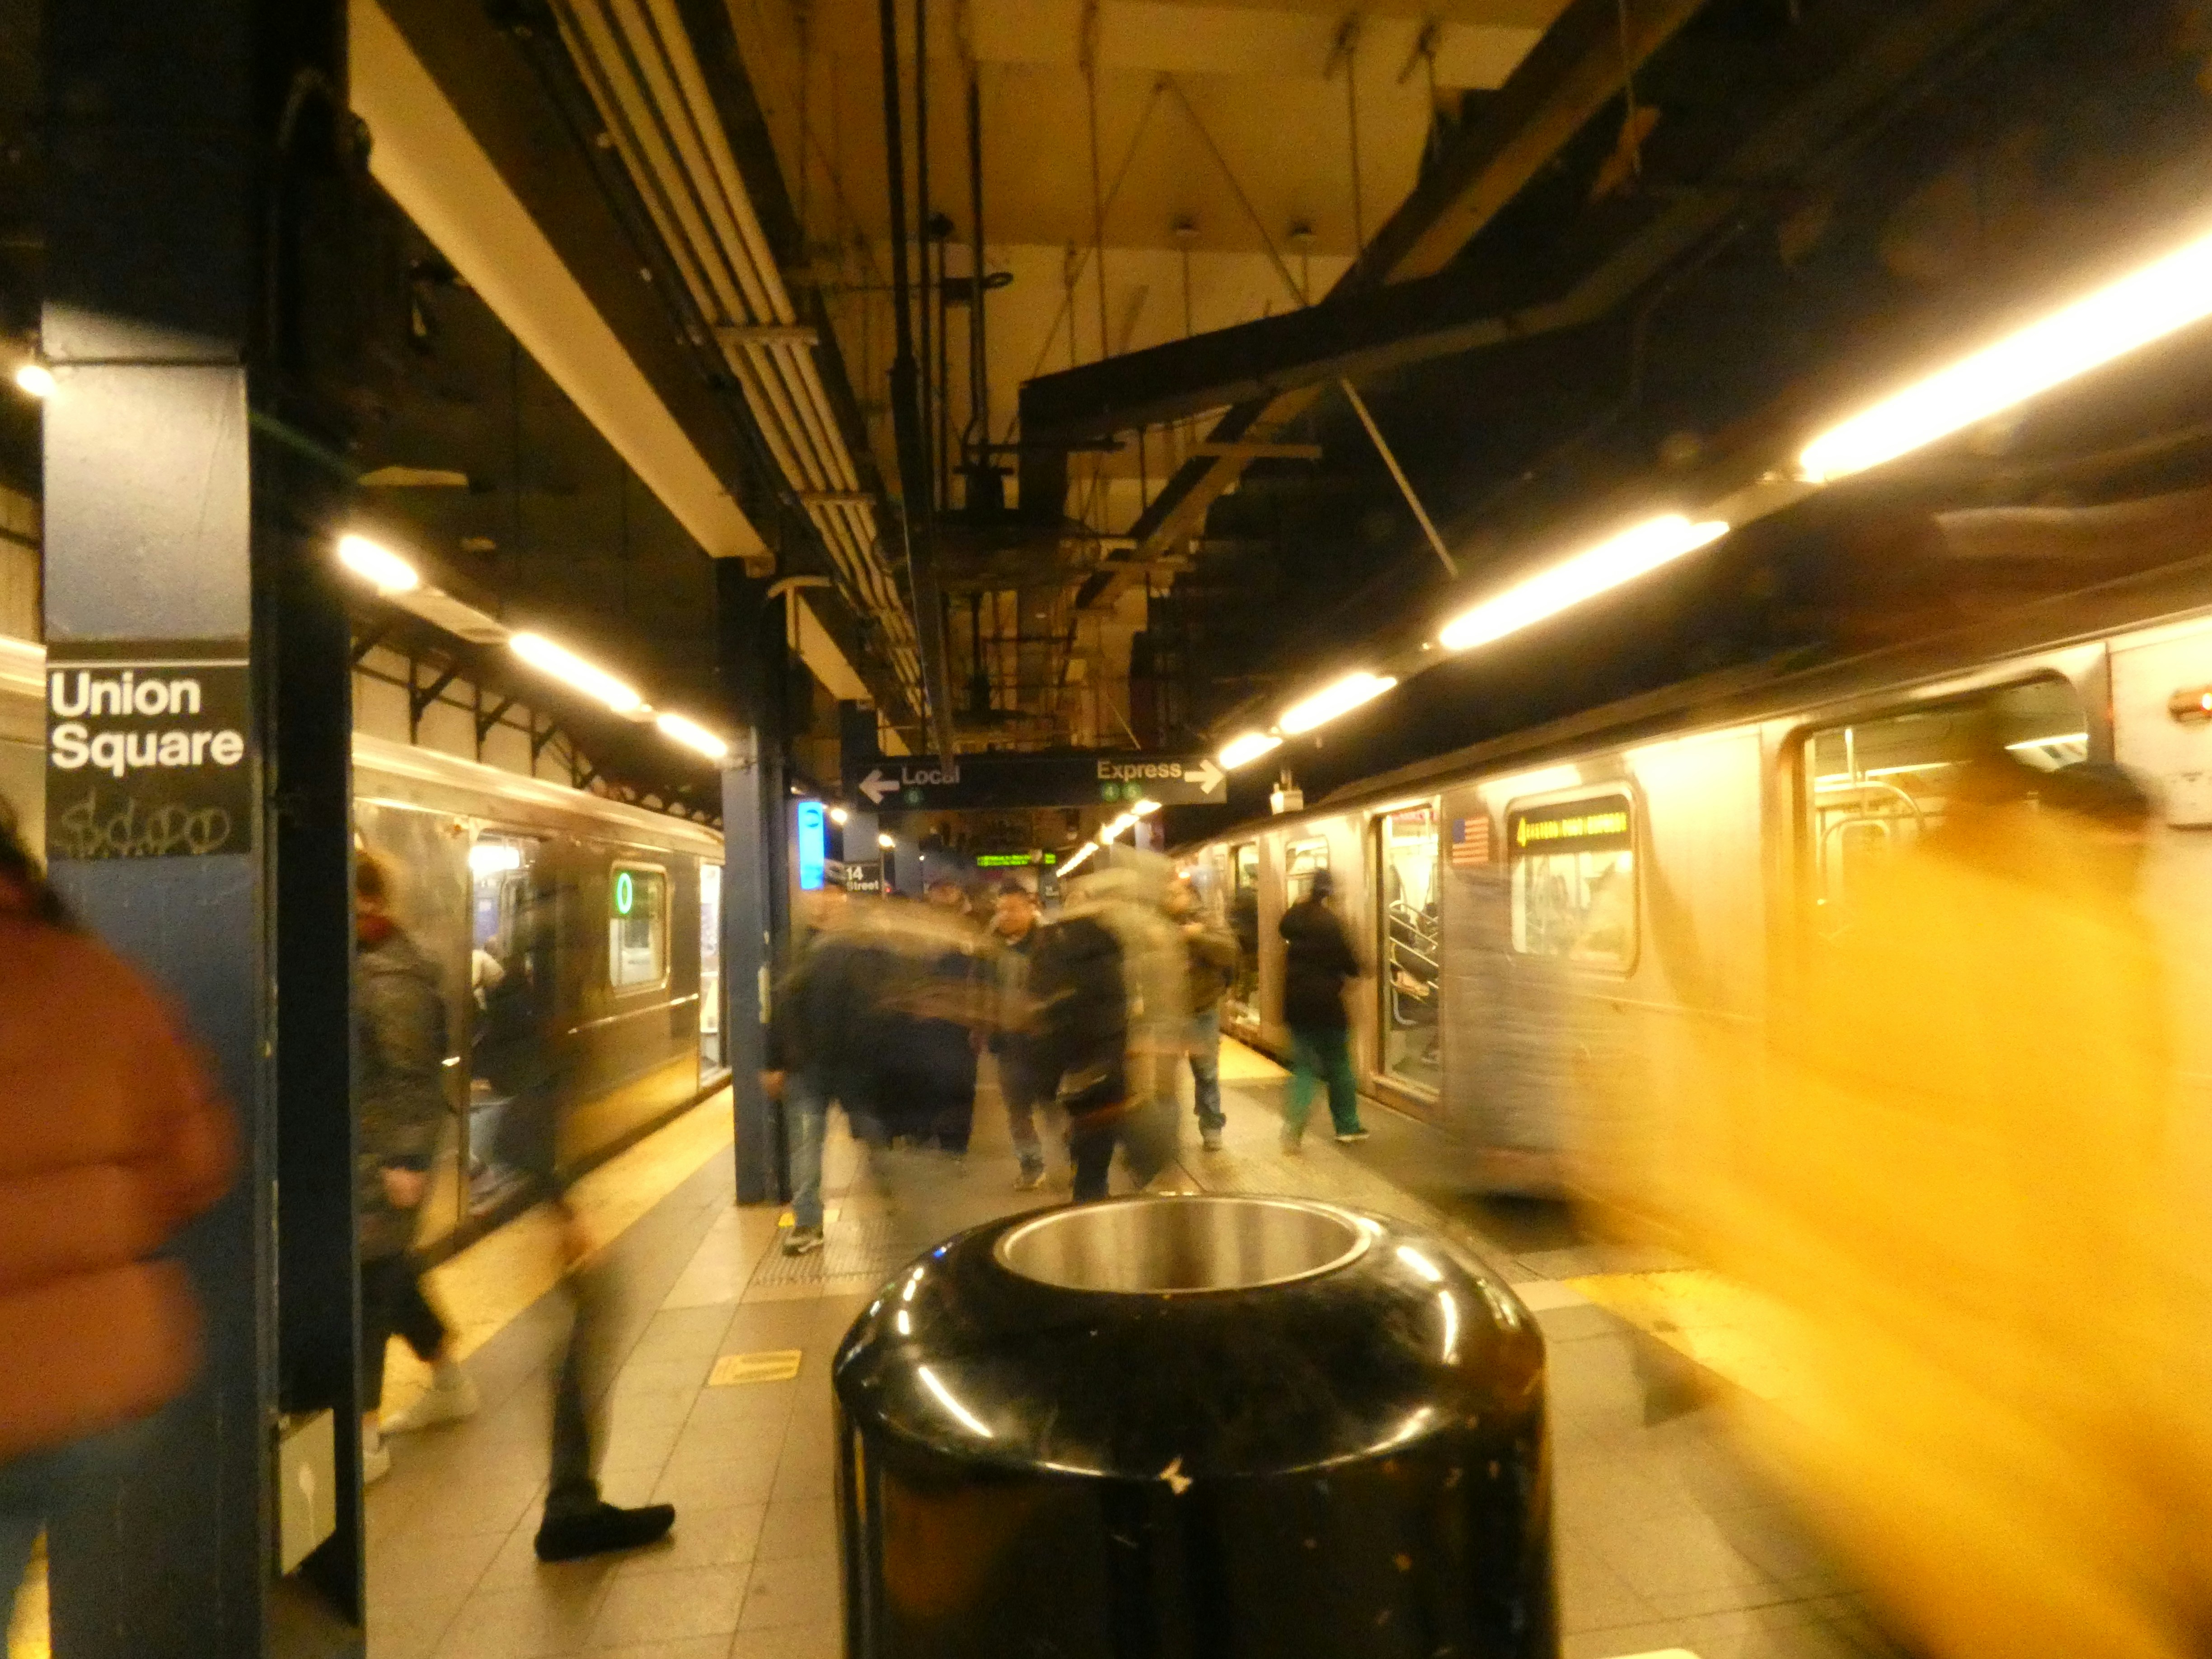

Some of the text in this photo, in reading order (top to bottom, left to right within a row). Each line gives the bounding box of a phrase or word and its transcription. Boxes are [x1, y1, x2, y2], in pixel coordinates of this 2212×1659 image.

[51, 670, 201, 717] Union
[51, 722, 244, 778] Square
[1097, 760, 1182, 782] Express
[846, 866, 863, 881] 14
